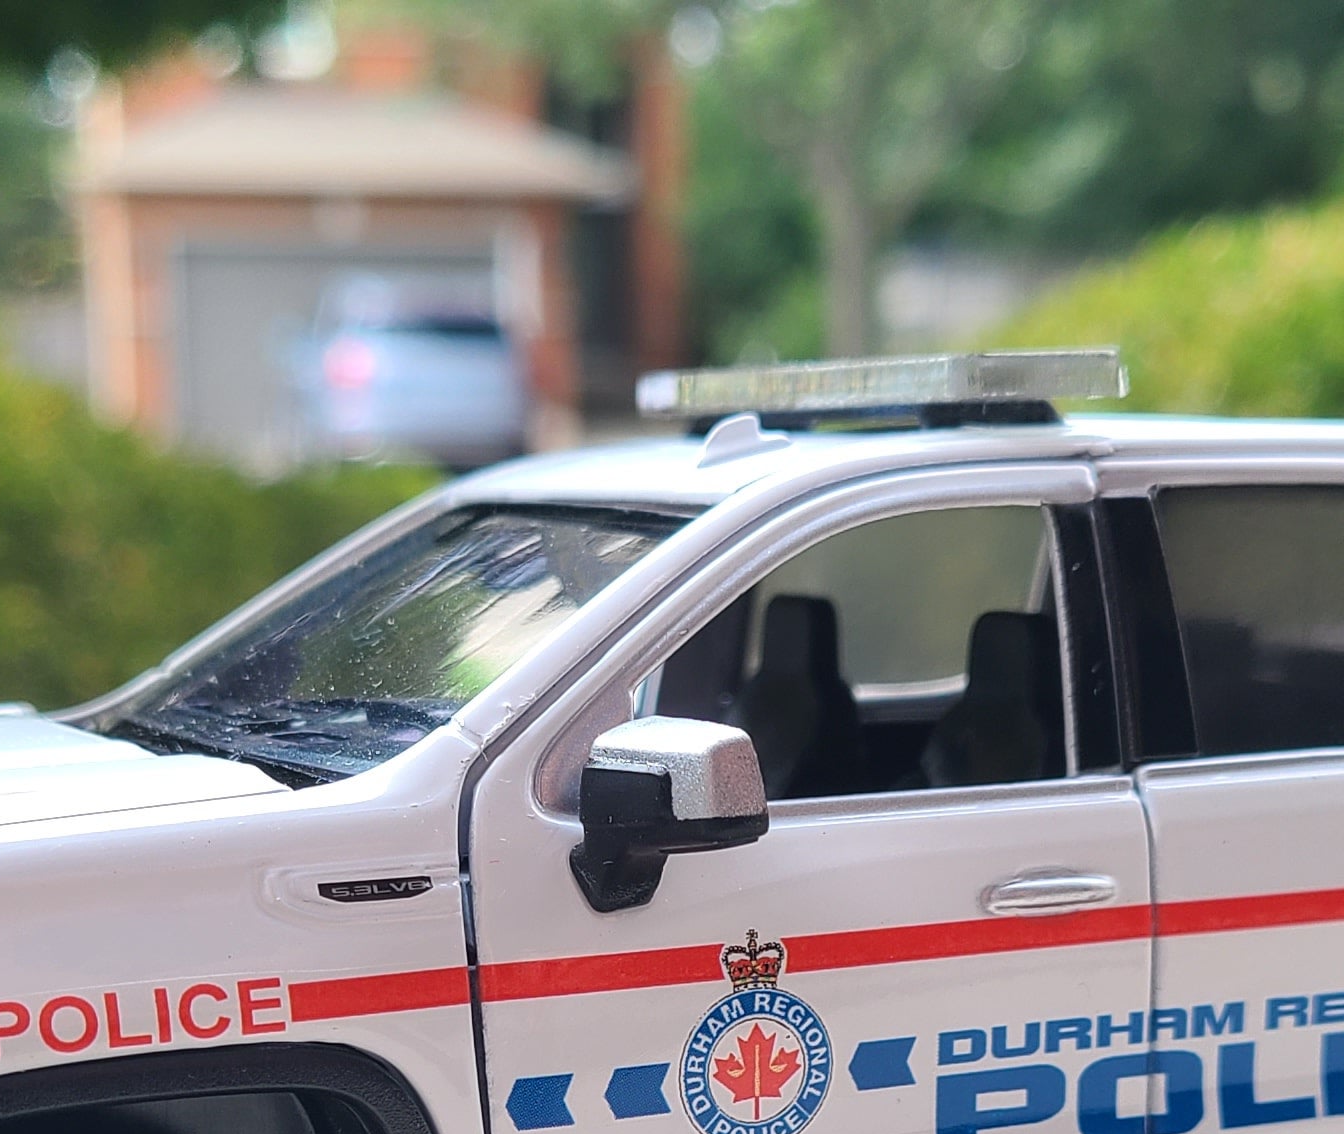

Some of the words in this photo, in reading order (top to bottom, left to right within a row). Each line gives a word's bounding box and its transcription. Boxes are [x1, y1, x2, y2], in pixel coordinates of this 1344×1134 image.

[685, 998, 745, 1117] DURHAM
[754, 992, 828, 1100] REGIONAL
[936, 1001, 1244, 1066] DURHAM
